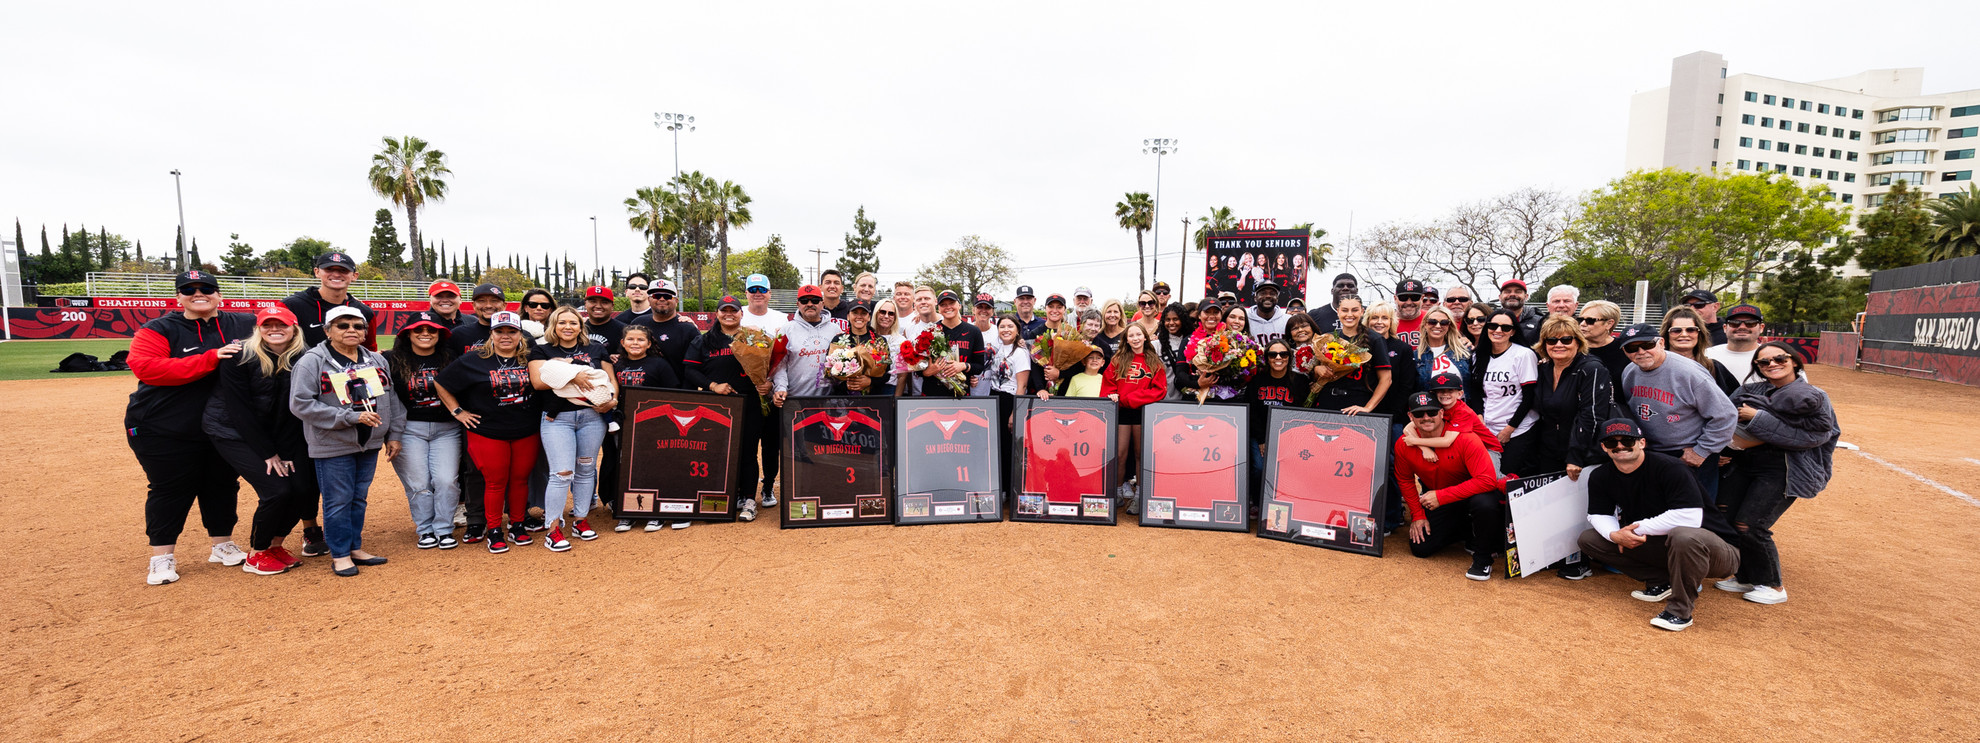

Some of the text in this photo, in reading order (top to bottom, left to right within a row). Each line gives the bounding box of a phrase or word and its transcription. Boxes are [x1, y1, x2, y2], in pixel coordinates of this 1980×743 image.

[1237, 218, 1276, 230] AZTECS
[61, 312, 86, 321] 200
[1914, 318, 1937, 346] SAN
[1934, 318, 1974, 350] DIEGO
[1486, 372, 1510, 382] TECS
[1502, 384, 1516, 396] 23
[1654, 388, 1675, 406] STATE
[1666, 414, 1680, 422] 23
[656, 439, 708, 451] SAN DIEGO STATE
[814, 444, 861, 454] SAN DIEGO STATE
[926, 443, 970, 454] SAN DIEGO STATE
[1073, 442, 1090, 456] 10
[1202, 447, 1221, 462] 26
[690, 461, 708, 477] 33
[846, 467, 856, 484] 3
[956, 466, 970, 482] 11
[1334, 461, 1354, 478] 23
